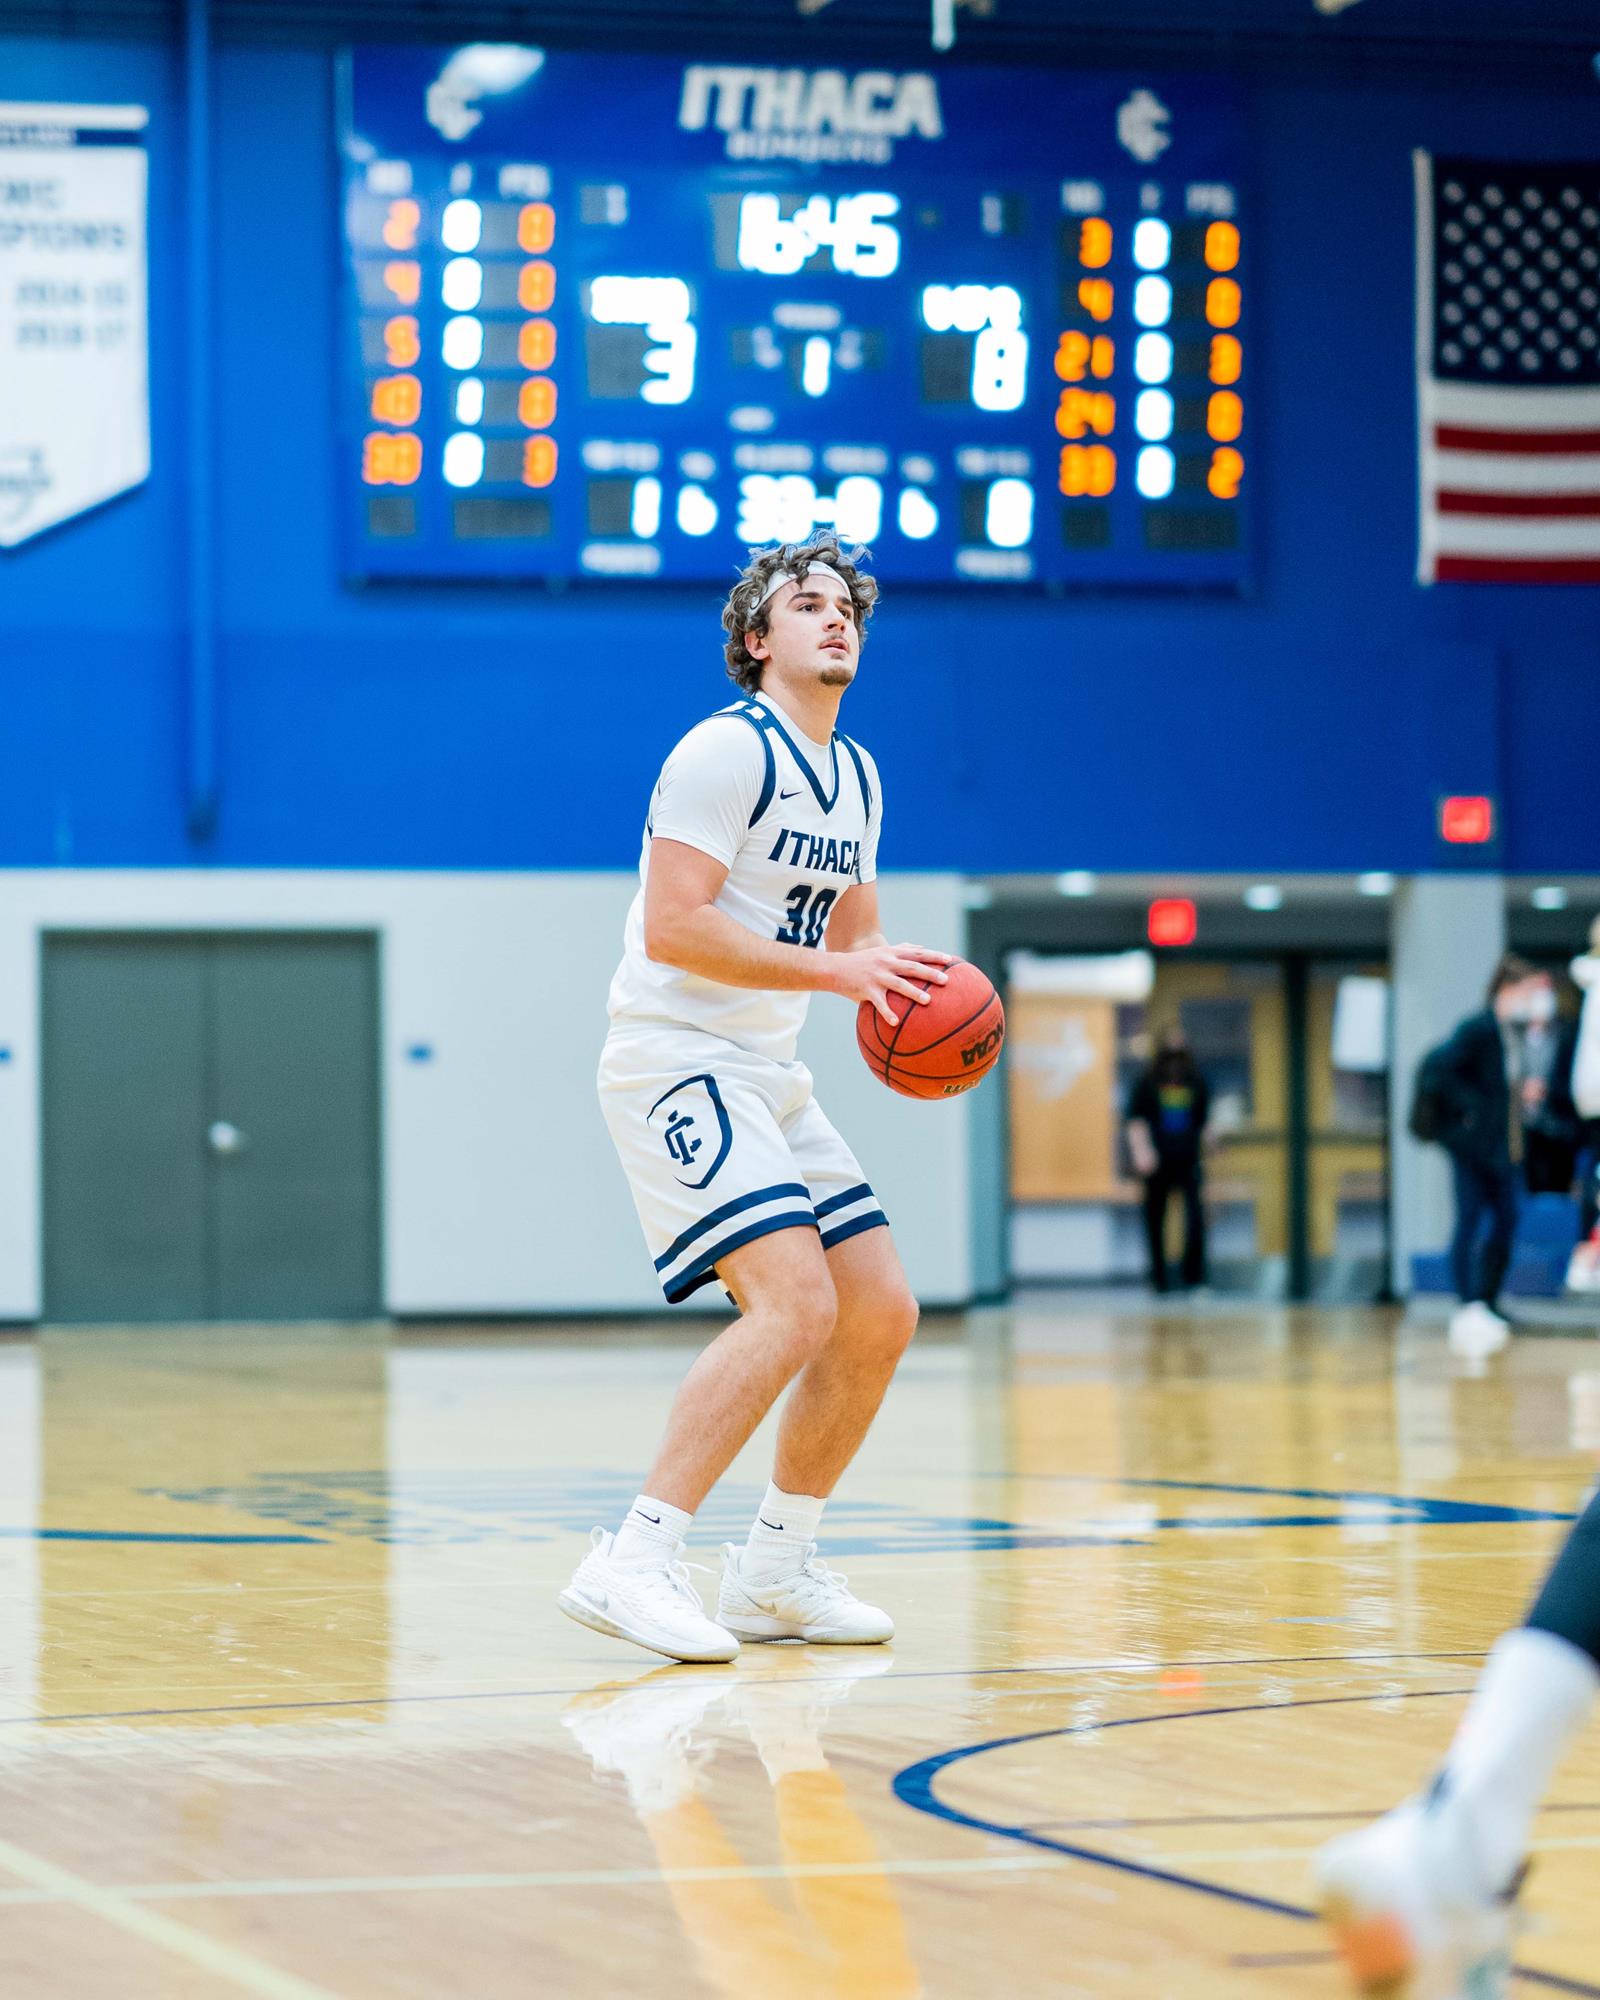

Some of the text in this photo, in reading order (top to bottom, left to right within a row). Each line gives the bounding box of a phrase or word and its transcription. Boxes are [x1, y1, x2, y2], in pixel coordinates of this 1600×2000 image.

[678, 64, 943, 139] ITHACA
[383, 199, 420, 251] 2
[738, 192, 899, 278] 16:45
[384, 315, 421, 367] 5
[640, 319, 698, 404] 3
[803, 336, 831, 396] 1
[971, 328, 1028, 411] 8
[1054, 330, 1115, 382] 21
[456, 376, 484, 426] 1
[1208, 446, 1244, 499] 2
[632, 477, 661, 538] 1
[775, 883, 839, 949] 30
